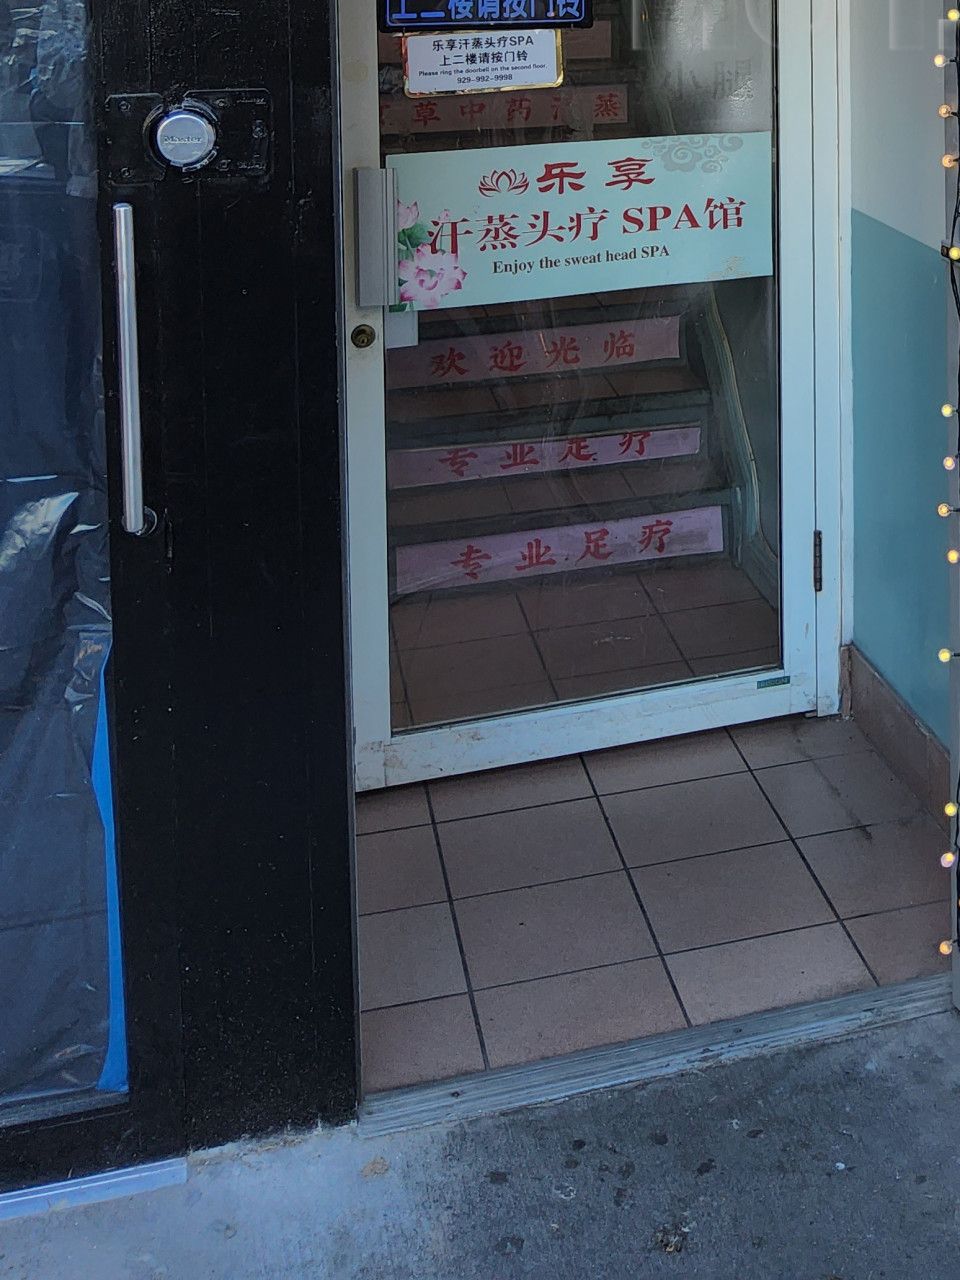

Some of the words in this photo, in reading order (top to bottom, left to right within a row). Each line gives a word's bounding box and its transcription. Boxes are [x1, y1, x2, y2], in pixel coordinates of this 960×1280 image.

[439, 50, 528, 67] 上二楼请按门铃
[440, 69, 452, 77] ring
[465, 66, 489, 74] doorbell
[537, 157, 655, 194] 乐享
[493, 259, 535, 276] Enjoy
[539, 255, 561, 269] the
[564, 252, 601, 267] sweat
[605, 247, 637, 262] head
[641, 245, 670, 259] SPA
[430, 329, 636, 379] 欢迎光临
[438, 430, 652, 477] 专业足疗
[450, 519, 675, 580] 专业足疗
